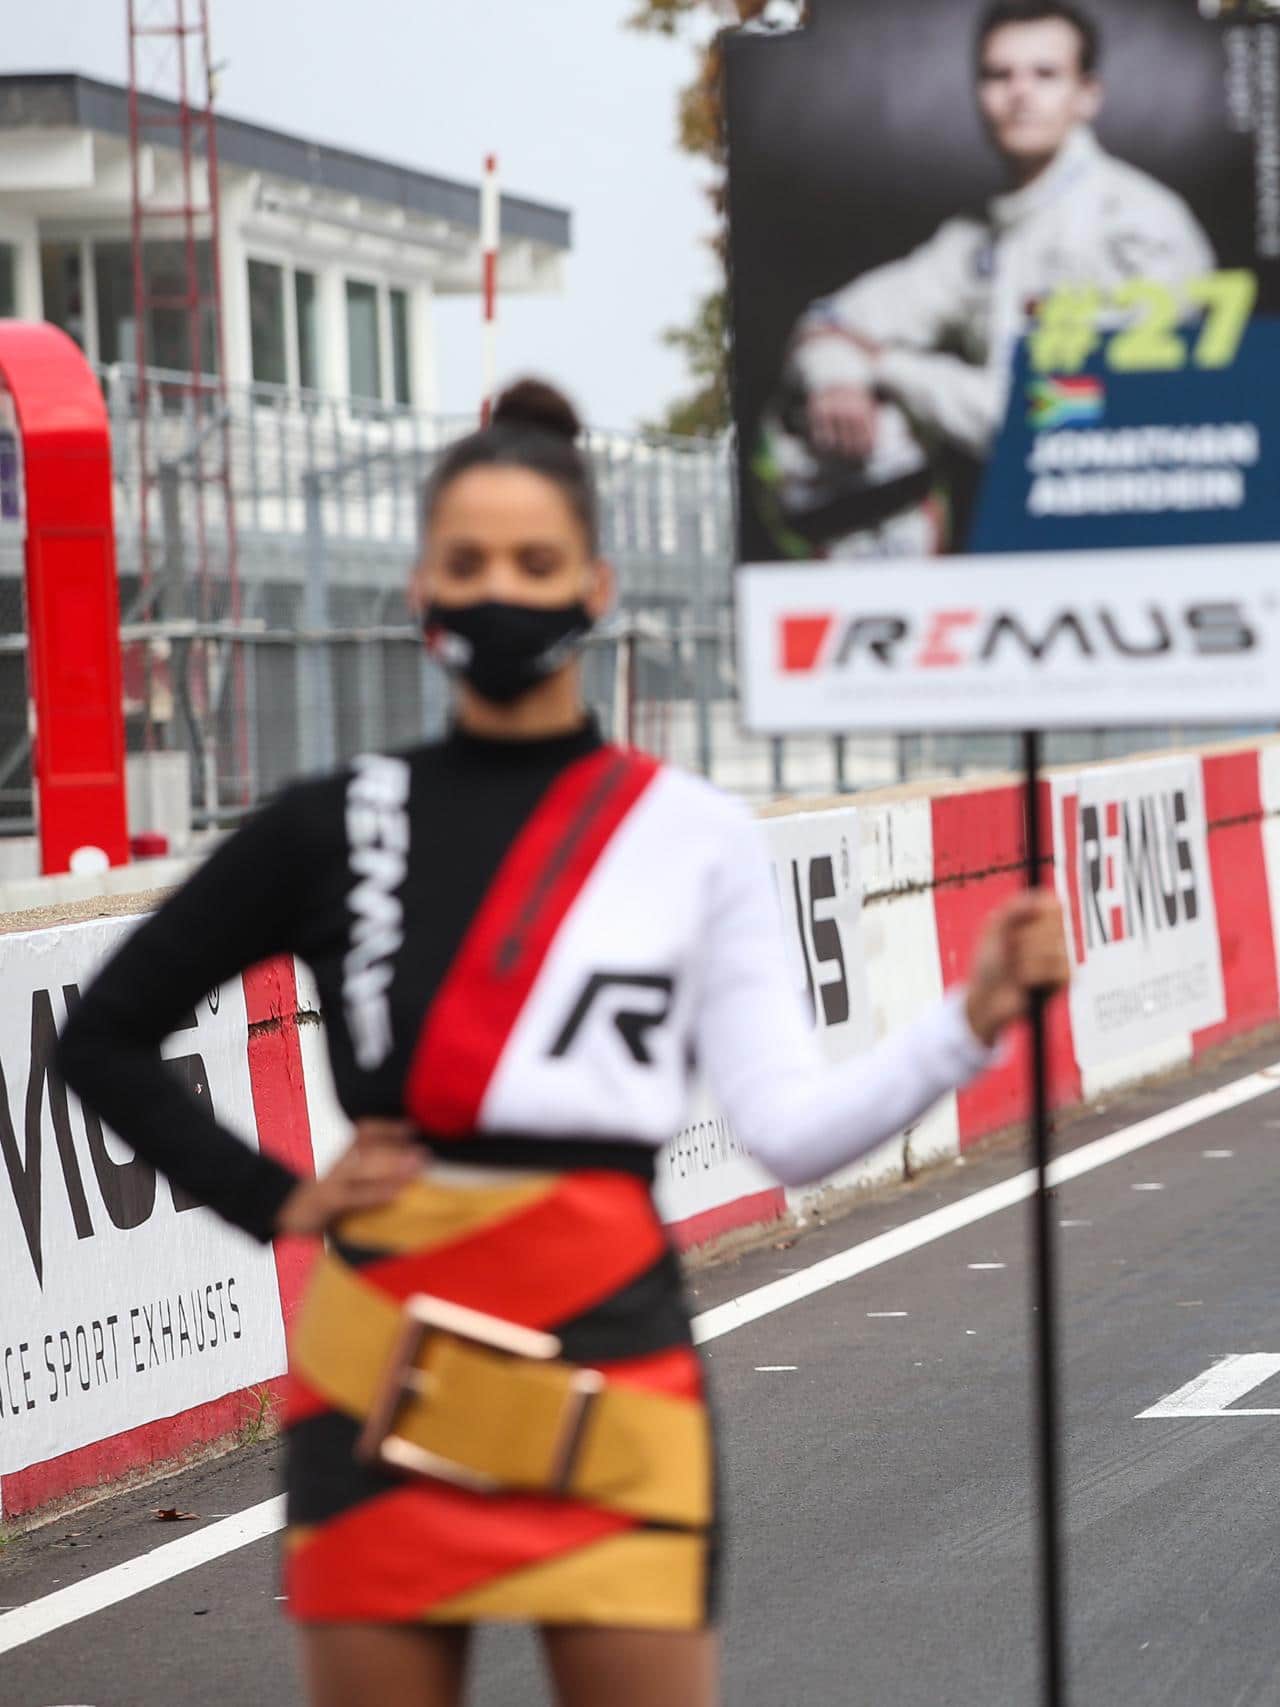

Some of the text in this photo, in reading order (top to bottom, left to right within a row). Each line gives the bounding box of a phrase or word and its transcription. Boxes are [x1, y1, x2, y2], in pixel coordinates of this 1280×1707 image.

[1028, 270, 1258, 371] #27
[836, 602, 1256, 668] REMUS
[1080, 790, 1199, 950] REMUS
[550, 972, 674, 1064] R
[43, 1315, 119, 1402] SPORT
[130, 1278, 242, 1373] EXHAUSTS
